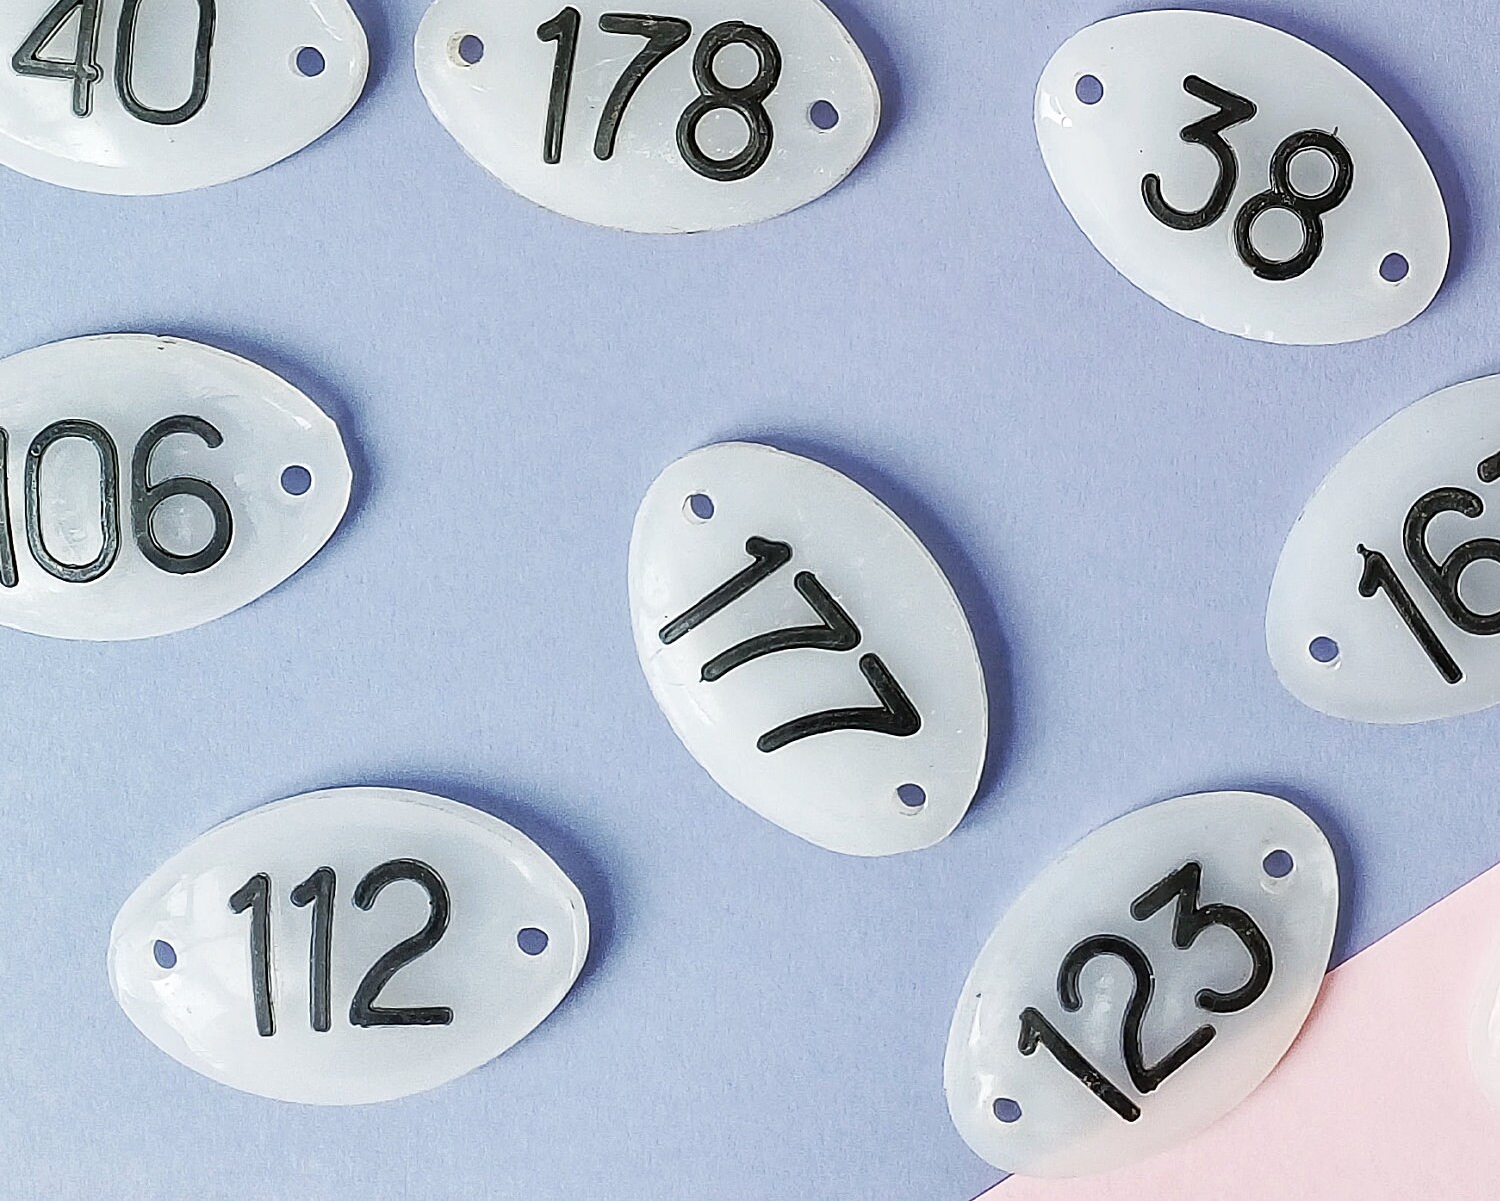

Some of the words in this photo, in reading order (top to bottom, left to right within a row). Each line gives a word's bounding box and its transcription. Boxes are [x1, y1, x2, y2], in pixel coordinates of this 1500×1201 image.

[537, 6, 782, 181] 178
[1141, 75, 1354, 281] 38
[660, 535, 922, 753] 177
[229, 859, 453, 1037] 112
[1018, 862, 1273, 1122] 123
